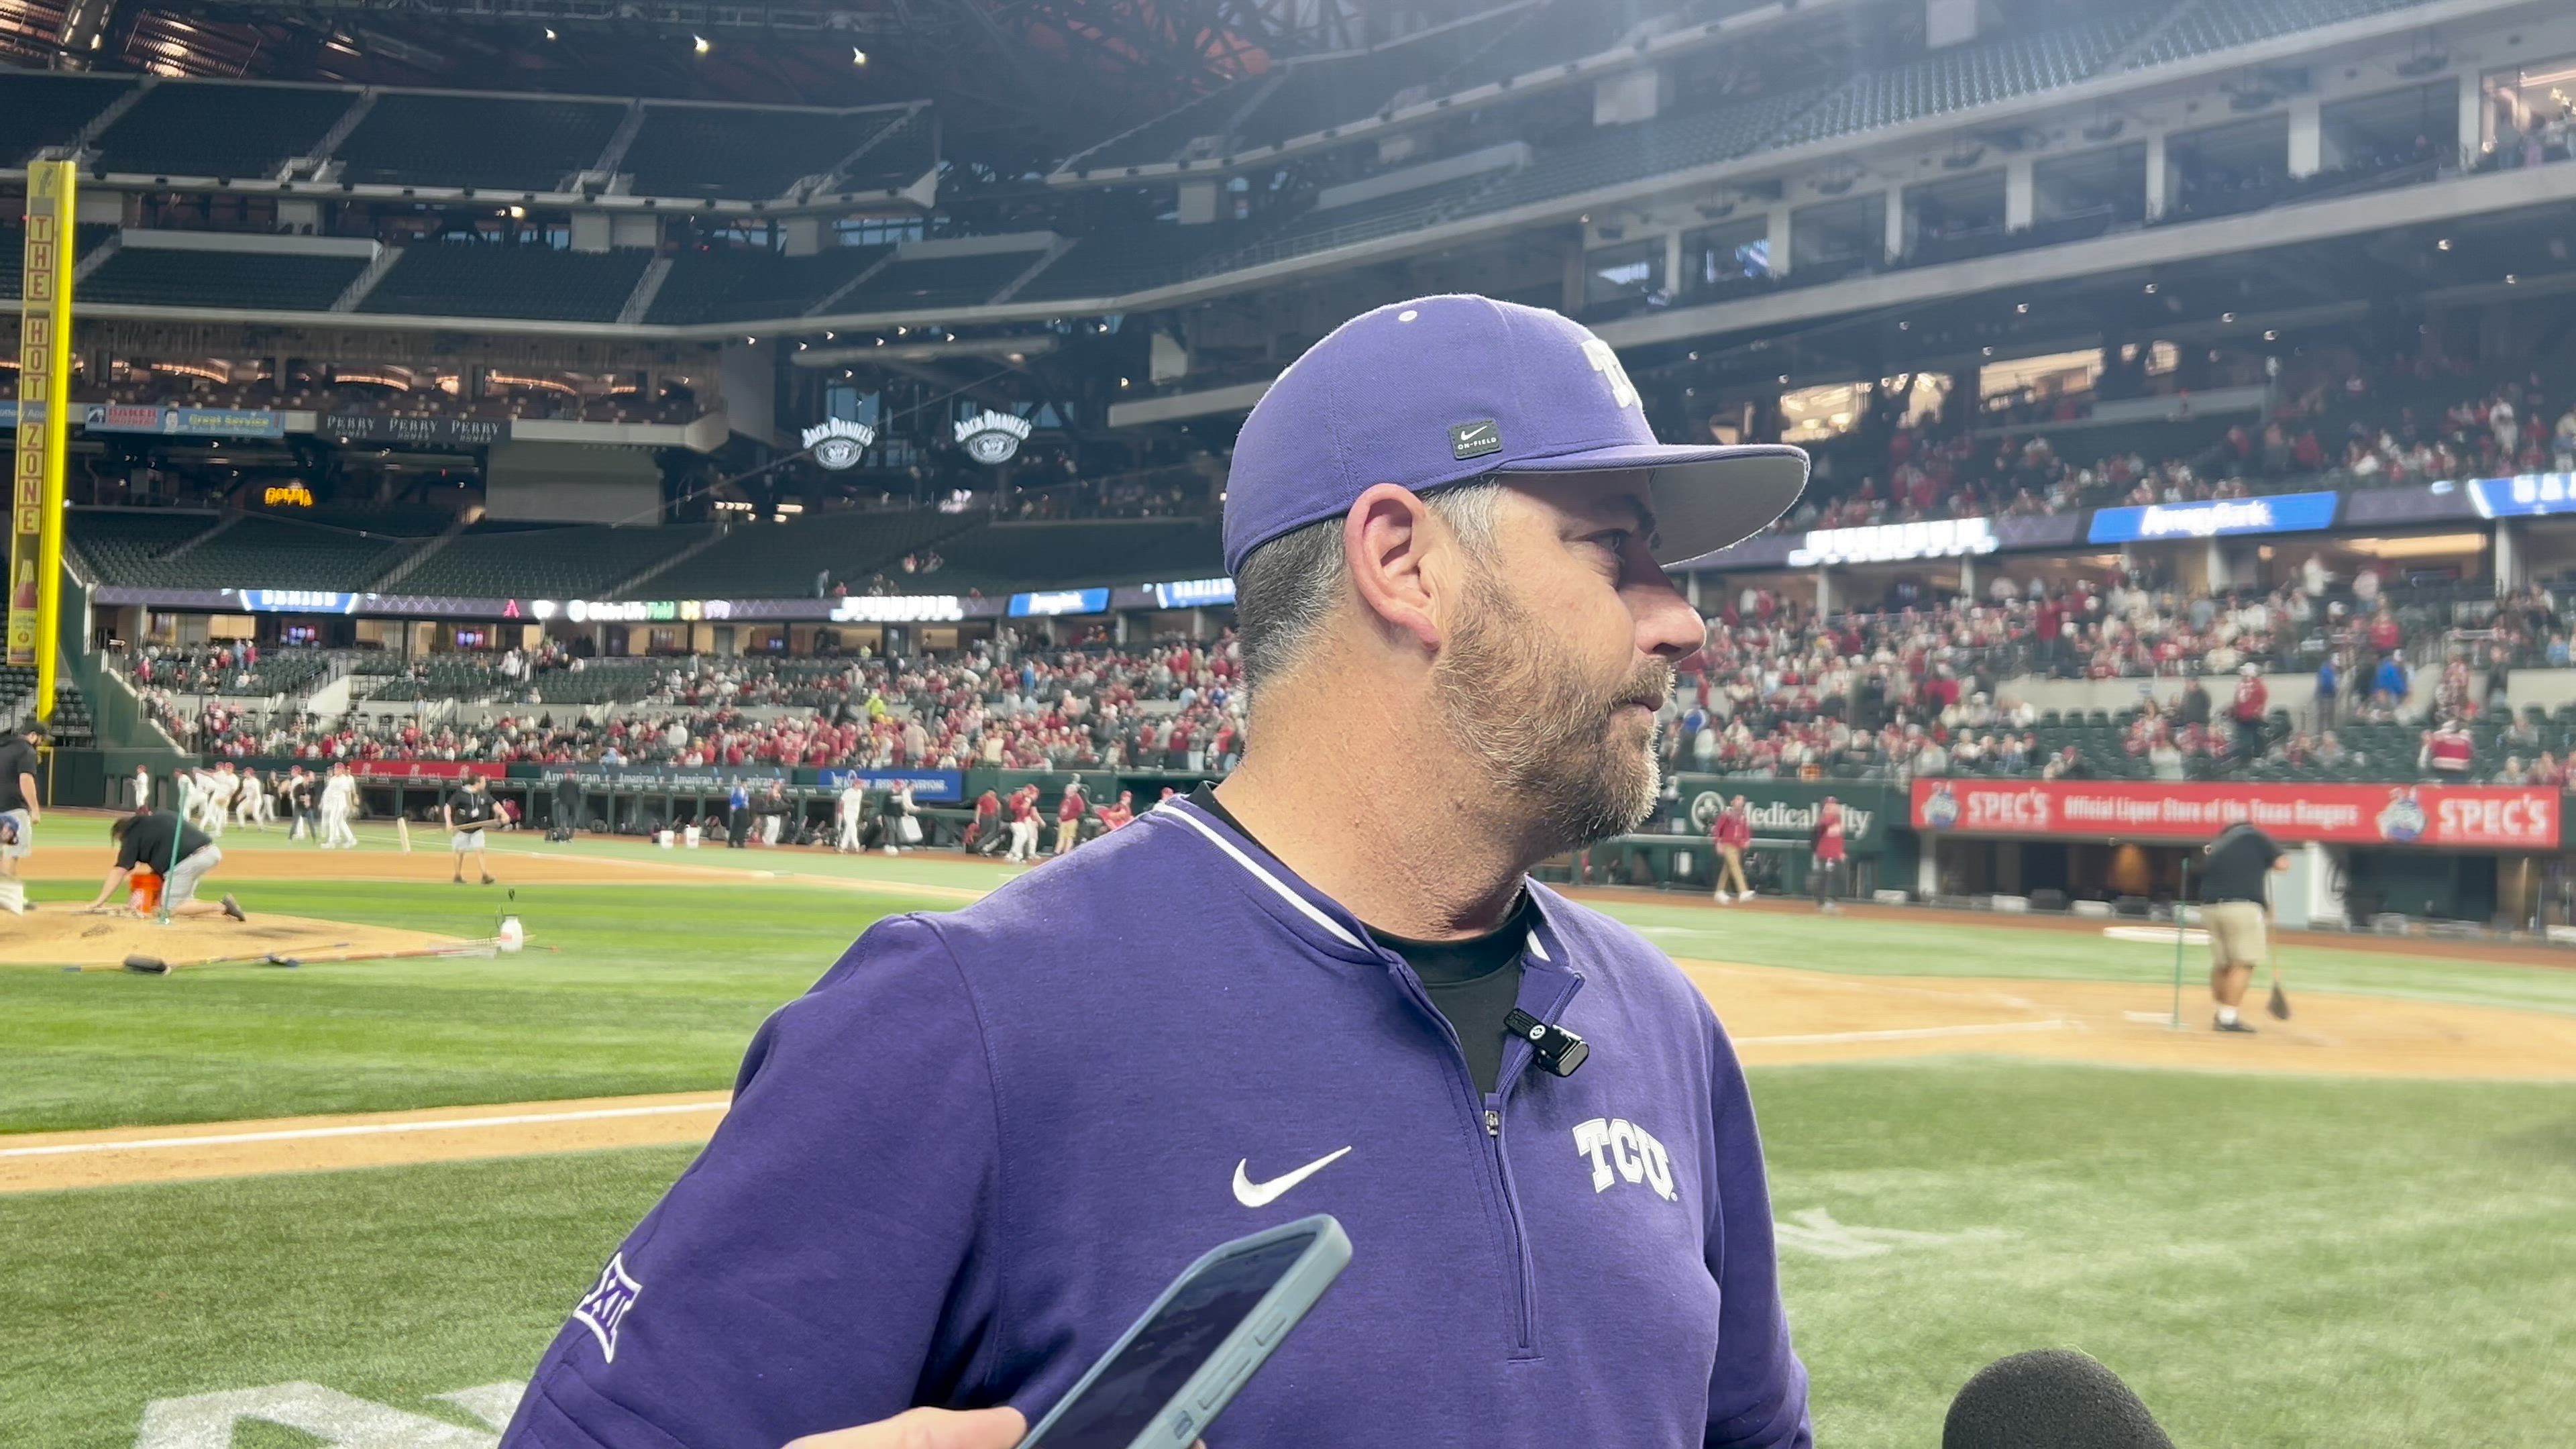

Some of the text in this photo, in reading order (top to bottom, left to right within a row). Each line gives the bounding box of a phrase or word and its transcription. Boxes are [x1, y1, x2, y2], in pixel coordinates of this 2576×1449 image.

[21, 217, 48, 533] THE HOT ZONE
[189, 413, 269, 427] Great Service
[327, 415, 376, 431] PERRY
[389, 418, 437, 432] PERRY
[451, 420, 499, 434] PERRY
[954, 415, 984, 443] JACK
[801, 423, 830, 449] JACK
[1457, 437, 1497, 450] ON-FIELD
[1968, 787, 2049, 823] SPEC'S
[2064, 794, 2113, 820] Official
[2116, 796, 2159, 825] Liquor
[2163, 798, 2201, 822] Store
[2204, 798, 2220, 822] of
[2222, 798, 2247, 823] the
[2438, 793, 2549, 835] SPEC'S
[1572, 1118, 1674, 1201] TCU
